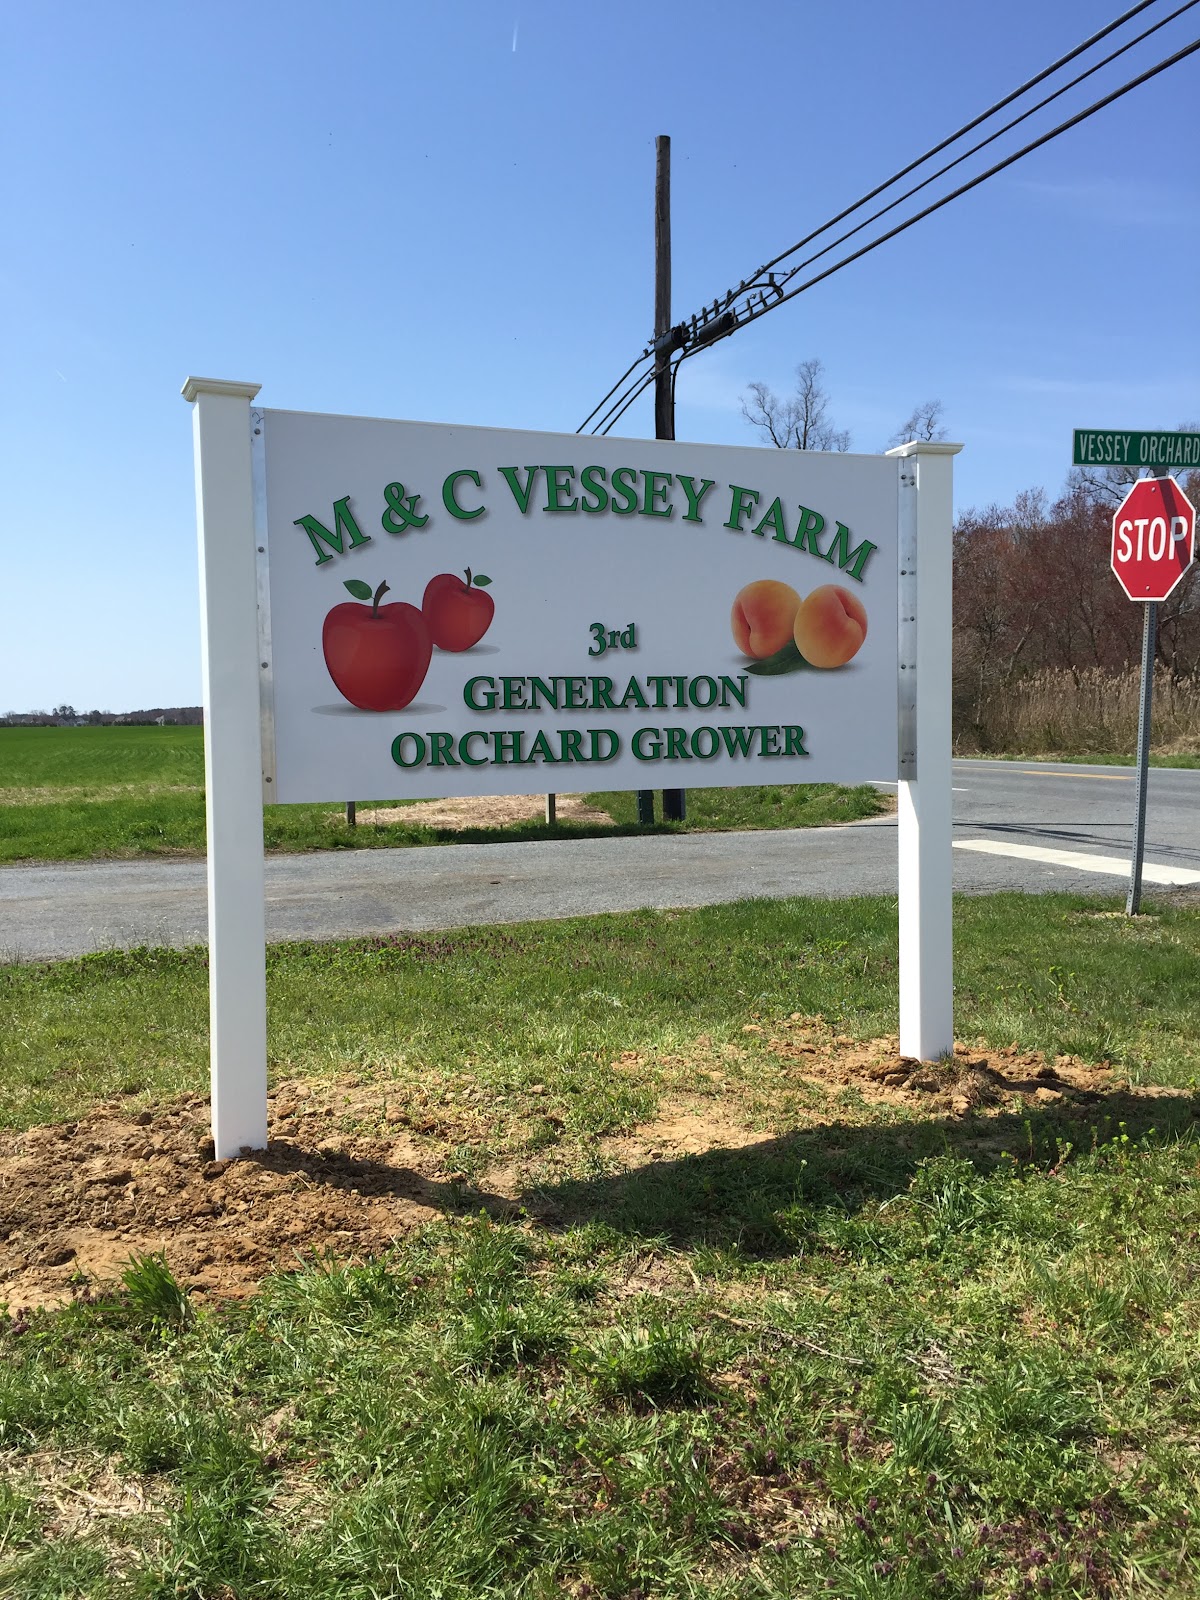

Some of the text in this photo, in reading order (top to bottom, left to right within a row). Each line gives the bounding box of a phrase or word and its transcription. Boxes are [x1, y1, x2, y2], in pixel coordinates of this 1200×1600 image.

[1080, 434, 1200, 463] VESSEY ORCHARD
[293, 465, 877, 582] M & C VESSEY FARM
[1117, 516, 1188, 562] STOP
[588, 622, 637, 656] 3rd
[463, 675, 748, 711] GENERATION
[390, 725, 809, 769] ORCHARD GROWER
